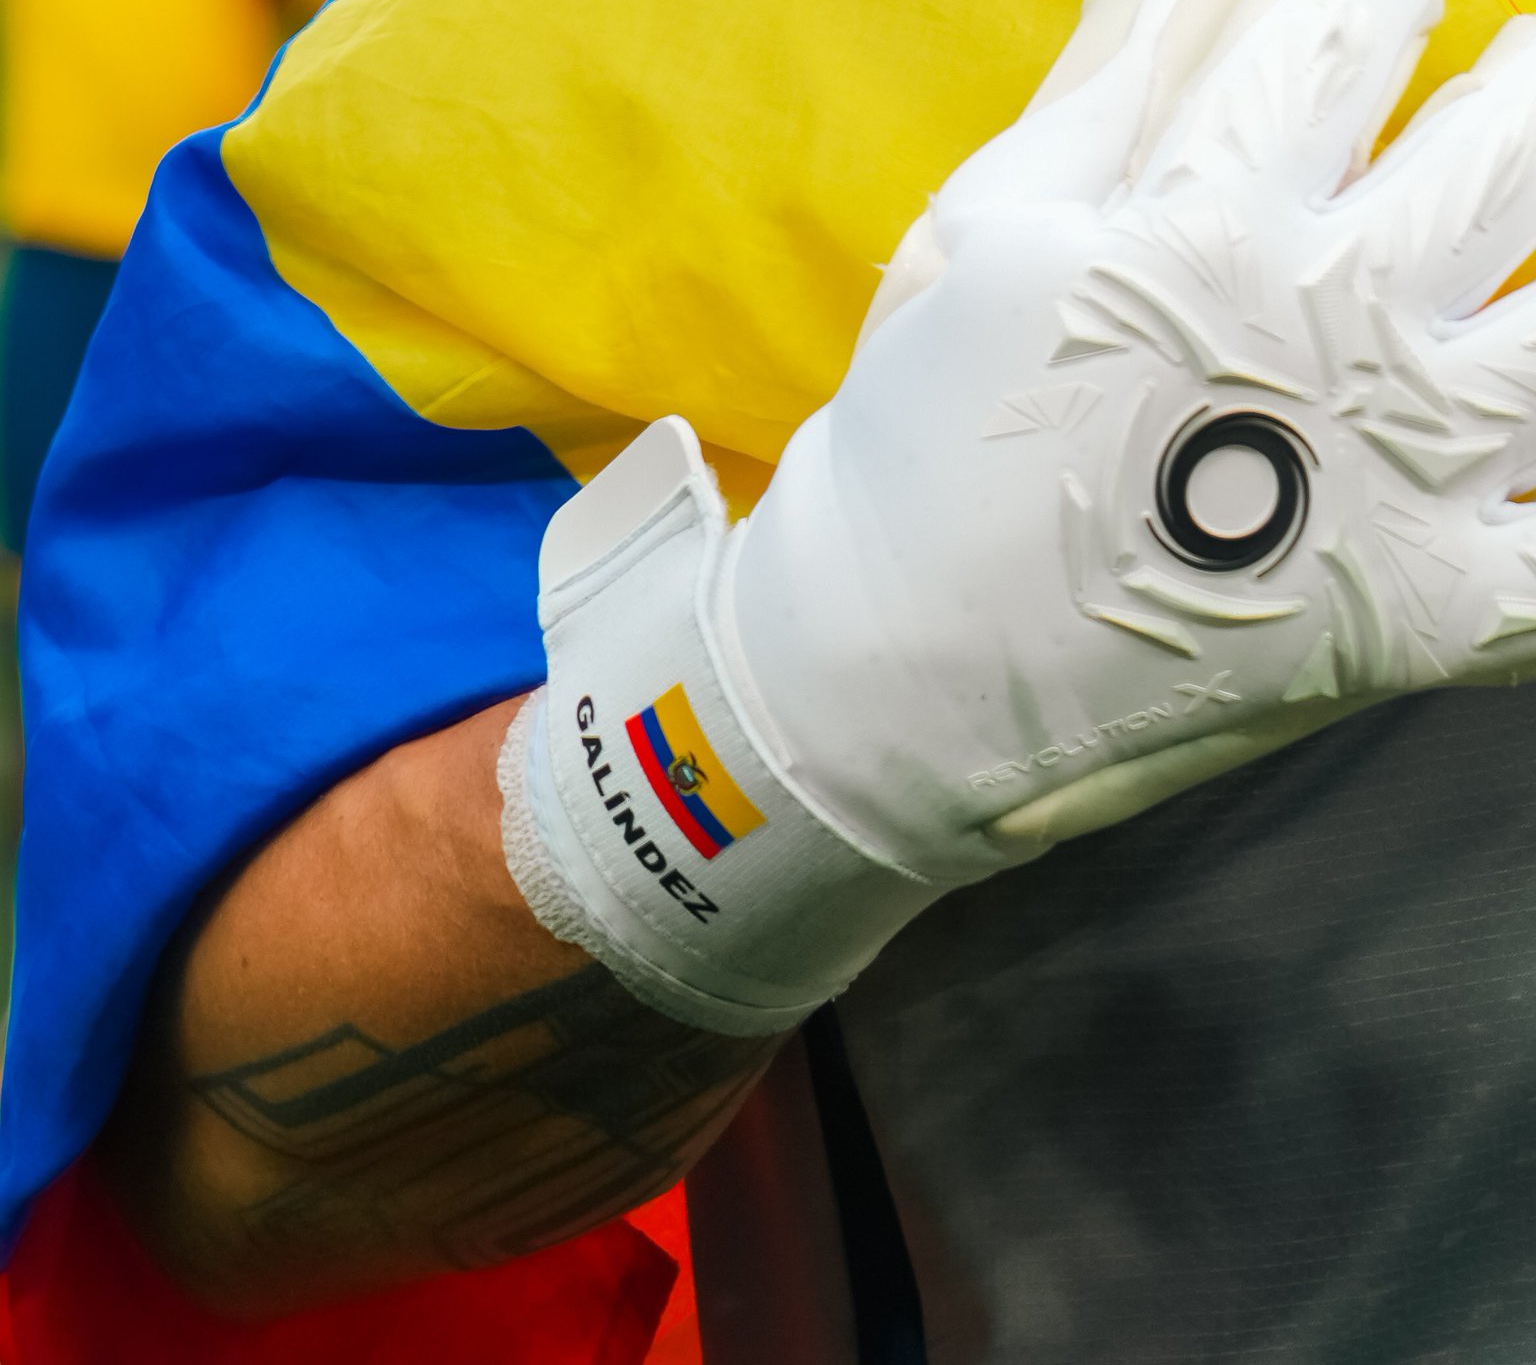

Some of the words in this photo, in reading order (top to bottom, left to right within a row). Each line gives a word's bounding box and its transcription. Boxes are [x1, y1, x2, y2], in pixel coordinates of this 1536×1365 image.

[577, 695, 719, 924] GALÍNDEZ
[968, 705, 1172, 789] REVOLUTION
[1171, 670, 1241, 714] X
